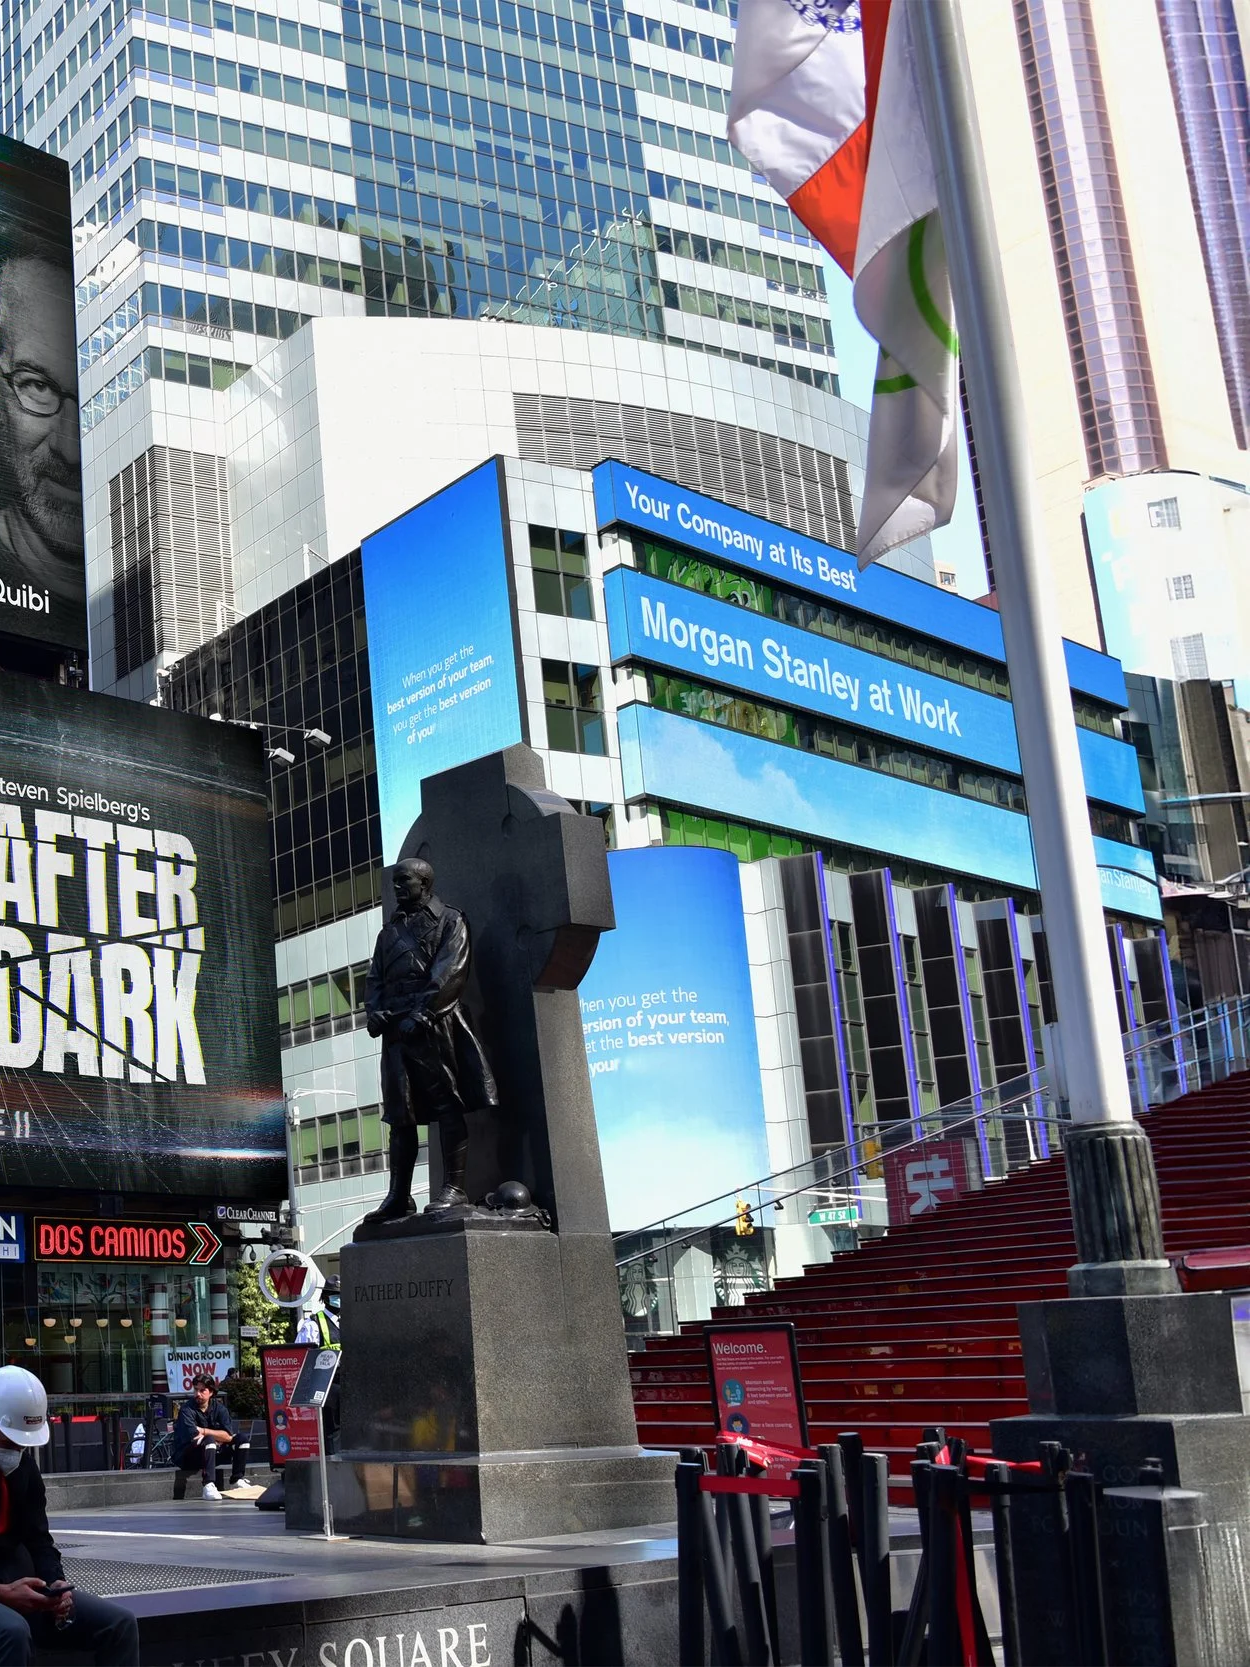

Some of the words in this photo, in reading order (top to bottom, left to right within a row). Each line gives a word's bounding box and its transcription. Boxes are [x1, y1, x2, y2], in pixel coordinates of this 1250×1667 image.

[625, 481, 670, 522] Your
[677, 503, 763, 561] Company
[769, 542, 787, 567] at
[790, 546, 813, 575] Its
[817, 556, 857, 592] Best
[402, 670, 426, 689] When
[427, 662, 443, 679] you
[444, 652, 458, 671] get
[460, 644, 474, 660] the
[640, 596, 753, 670] Morgan
[761, 638, 860, 711] Stanley
[869, 680, 894, 715] at
[898, 683, 962, 737] Work
[387, 697, 405, 715] best
[406, 683, 436, 705] version
[437, 674, 447, 689] of
[448, 666, 468, 687] your
[392, 720, 408, 736] you
[409, 710, 422, 729] get
[423, 704, 437, 718] the
[439, 692, 458, 711] best
[459, 678, 491, 701] version
[407, 729, 416, 745] of
[56, 787, 150, 822] Spielberg's
[580, 998, 604, 1013] hen
[608, 994, 636, 1012] you
[641, 989, 667, 1008] get
[671, 986, 698, 1003] the
[582, 1017, 622, 1034] ersion
[626, 1010, 643, 1027] of
[647, 1012, 686, 1029] your
[690, 1010, 729, 1027] team,
[585, 1041, 596, 1054] et
[600, 1034, 623, 1050] the
[628, 1031, 665, 1048] best
[668, 1029, 725, 1044] version
[828, 1211, 837, 1221] 47
[39, 1223, 83, 1257] DOS
[89, 1226, 186, 1259] CAMINOS
[268, 1265, 308, 1296] W
[354, 1283, 403, 1302] FATHER
[407, 1279, 454, 1299] DUFFY
[713, 1342, 767, 1355] Welcome.
[181, 1362, 217, 1376] NOW
[319, 1622, 491, 1667] SQUARE
